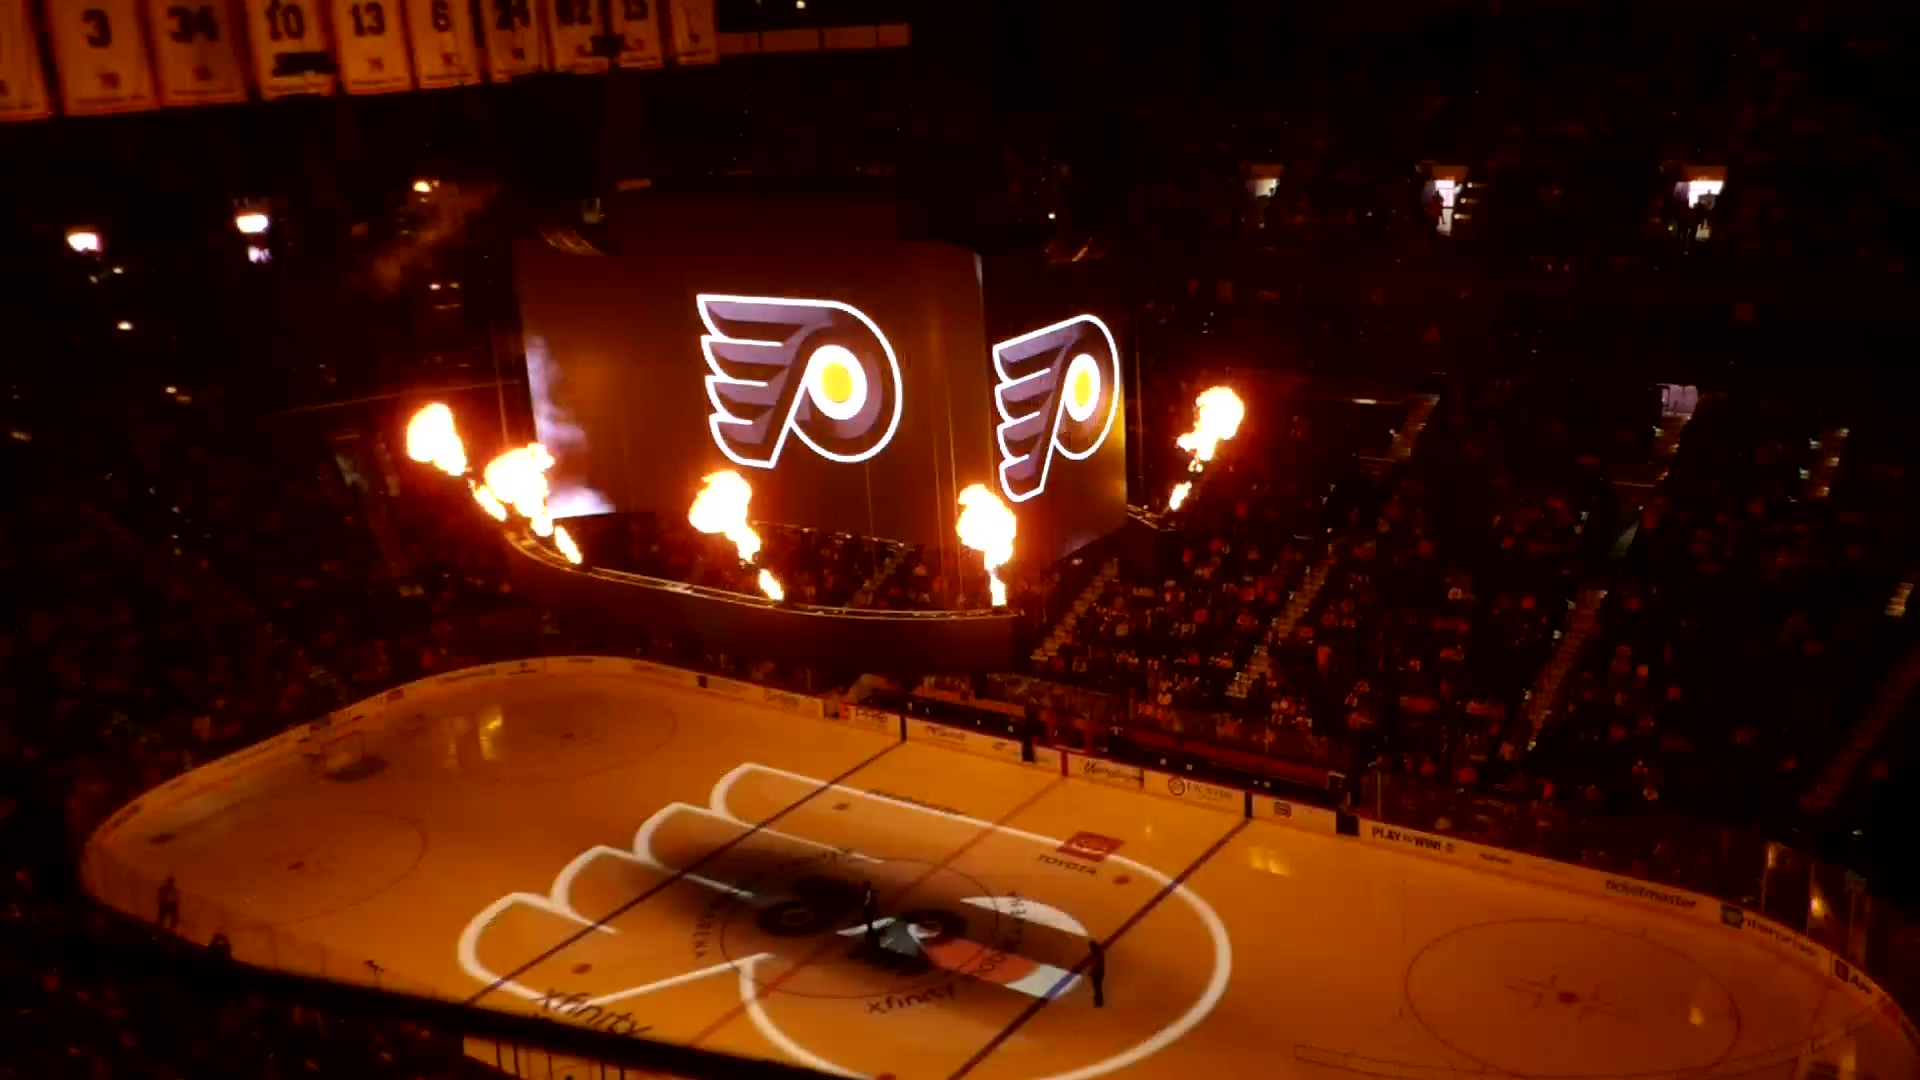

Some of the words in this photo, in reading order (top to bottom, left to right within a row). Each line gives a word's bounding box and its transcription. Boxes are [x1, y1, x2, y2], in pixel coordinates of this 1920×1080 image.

[83, 9, 111, 47] 3
[168, 6, 218, 42] 34
[266, 1, 305, 40] 10
[351, 2, 385, 36] 13
[431, 2, 450, 32] 6
[1371, 826, 1401, 842] PLAY
[1038, 854, 1097, 878] TOYOTA
[864, 982, 954, 1015] xfinity
